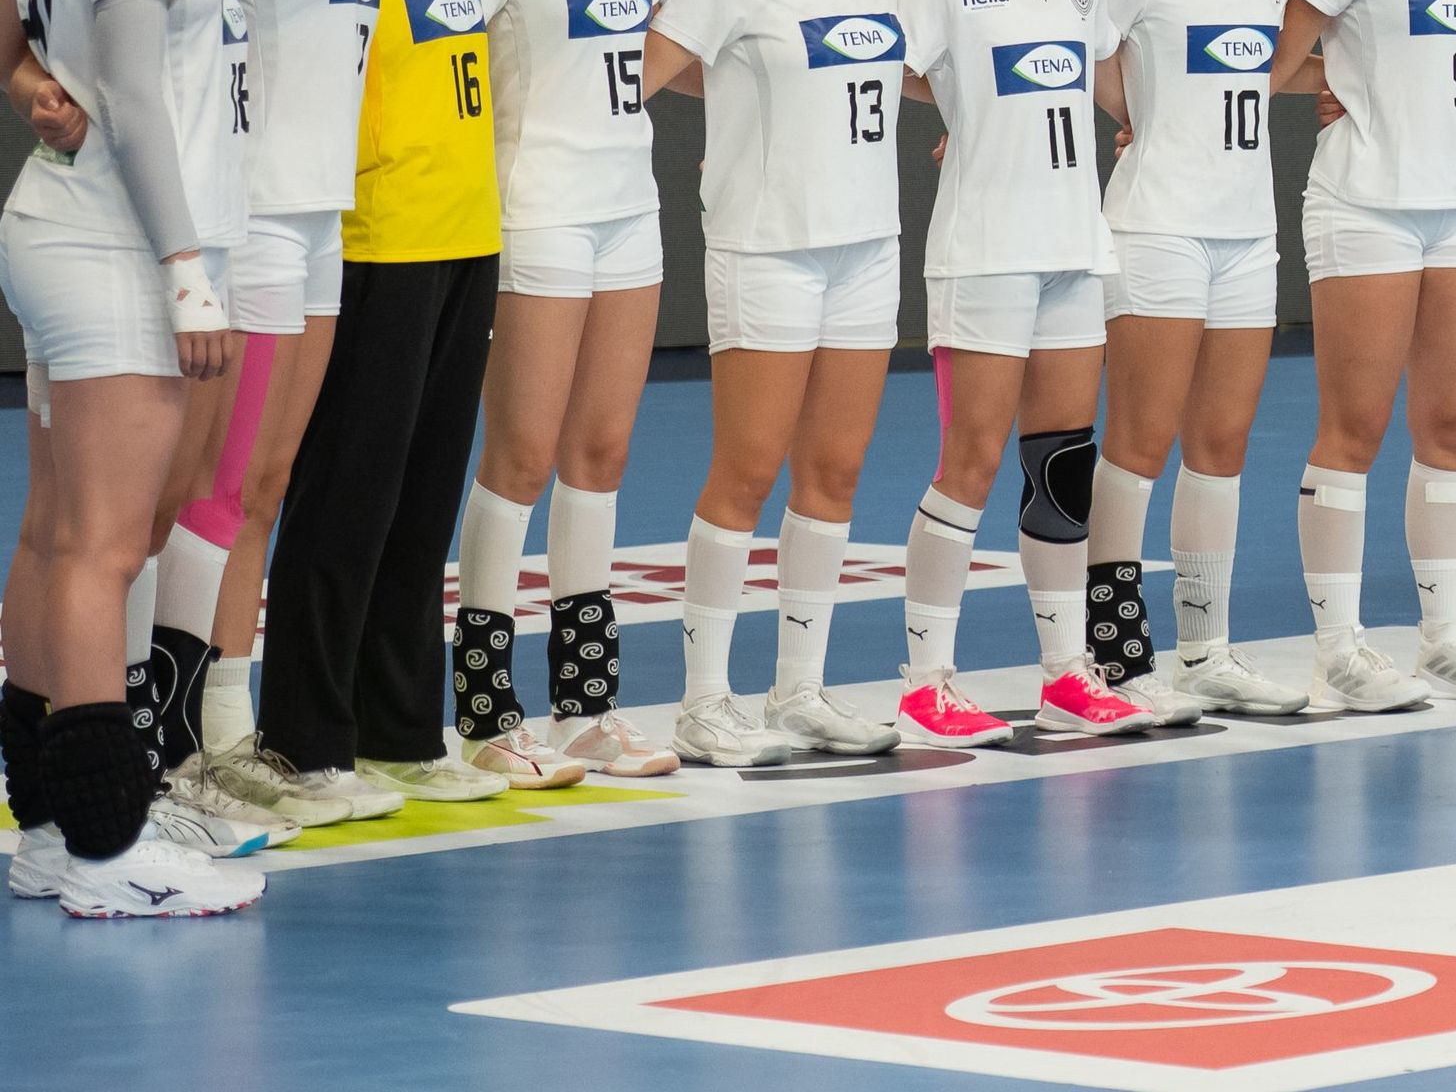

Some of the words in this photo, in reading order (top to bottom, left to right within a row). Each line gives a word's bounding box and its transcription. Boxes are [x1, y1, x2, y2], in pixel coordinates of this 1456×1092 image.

[440, 0, 476, 18] TENA
[599, 0, 638, 17] TENA
[838, 29, 884, 47] TENA
[1222, 41, 1263, 57] TENA
[451, 51, 482, 120] 16
[603, 50, 643, 116] 15
[1030, 58, 1074, 75] TENA
[847, 79, 884, 144] 13
[1224, 89, 1261, 151] 10
[1046, 106, 1078, 169] 11
